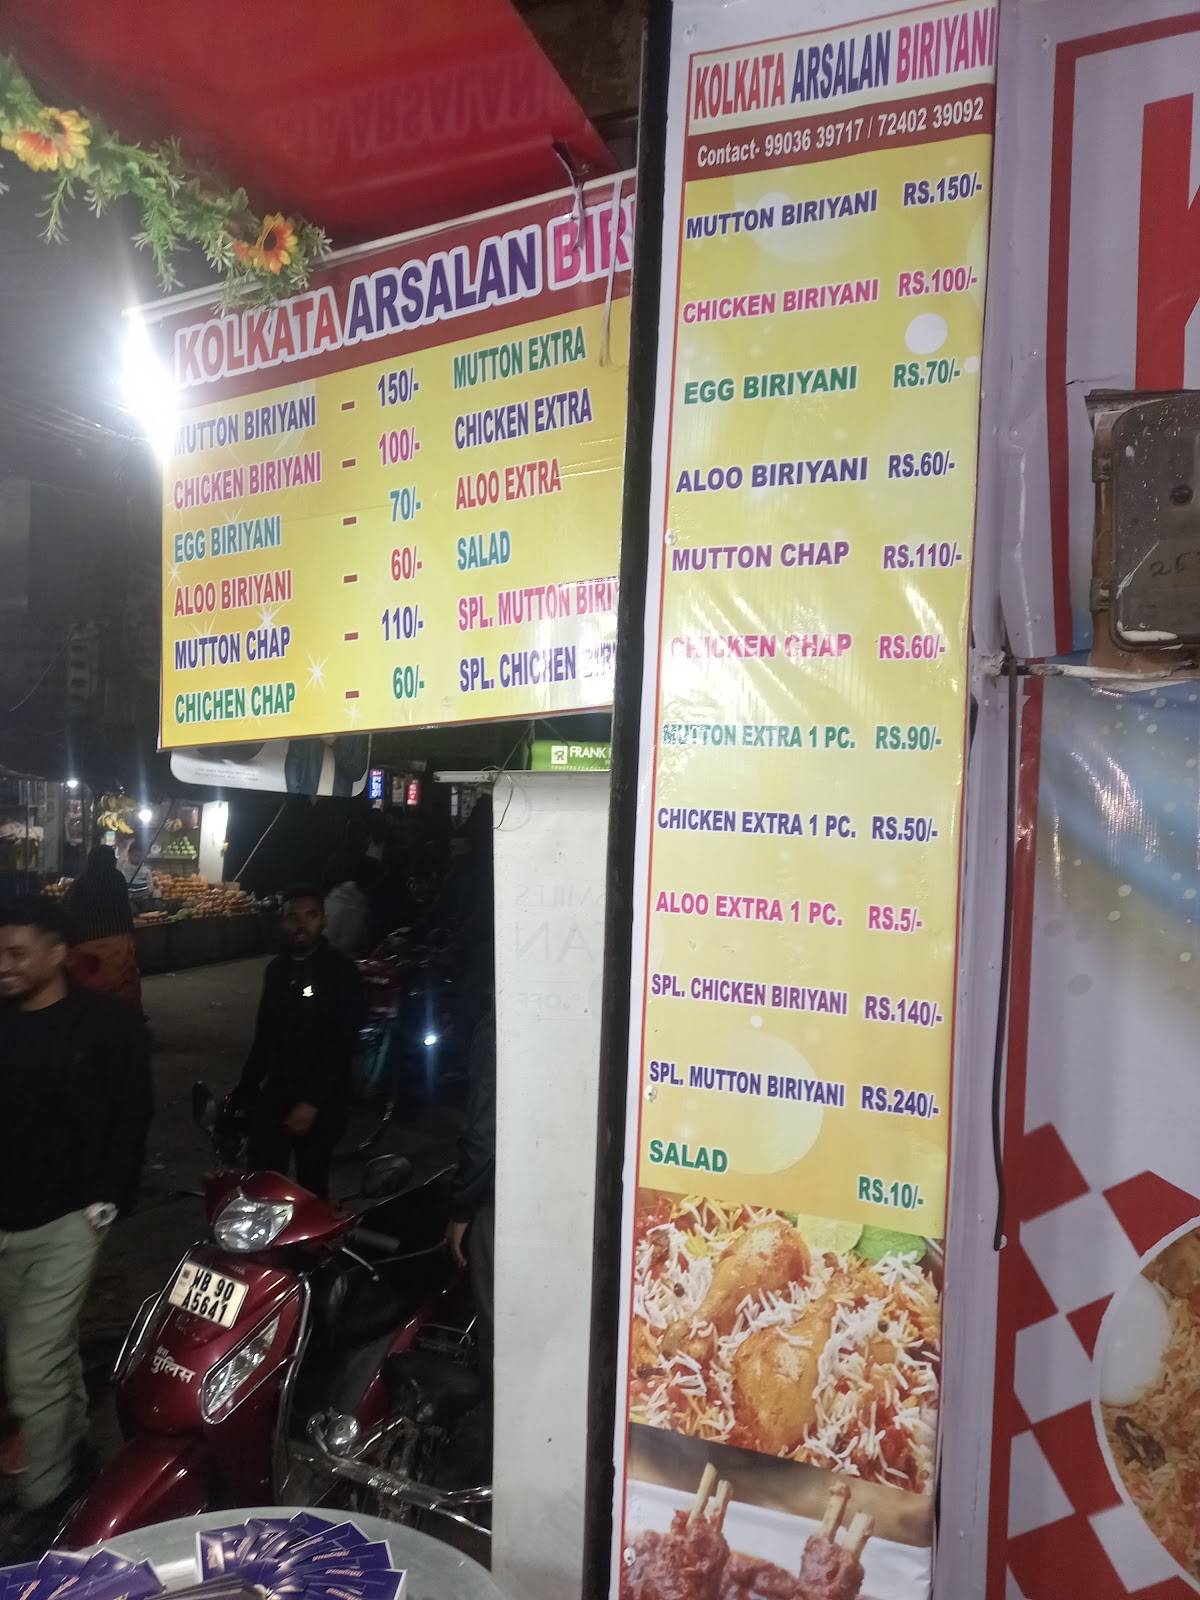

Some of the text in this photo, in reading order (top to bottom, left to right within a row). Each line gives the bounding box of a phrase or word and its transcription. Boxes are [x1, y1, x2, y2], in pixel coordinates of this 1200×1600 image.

[694, 7, 996, 120] KOLKATA ARSALAN BIRIYANI
[697, 140, 760, 167] Contact-
[765, 129, 811, 157] 99036
[816, 118, 863, 149] 39717
[878, 107, 927, 136] 72402
[932, 96, 984, 128] 39092
[686, 172, 982, 239] MUTTON BIRIYANI RS.150/-
[177, 203, 636, 384] KOLKATA ARSALAN BIR
[683, 266, 977, 324] CHICKEN BIRIYANI RS.100/-
[453, 326, 586, 389] MUTTON EXTRA
[684, 358, 960, 404] EGG BIRIYANI RS.70/-
[244, 396, 316, 440] BIRIYANI
[377, 367, 419, 407] 150/-
[454, 388, 592, 449] CHICKEN EXTRA
[174, 468, 243, 509] CHICKEN
[250, 451, 321, 494] BIRIYANI
[379, 428, 420, 465] 100/-
[456, 458, 562, 510] ALOO EXTRA
[676, 450, 955, 493] ALOO BIRIYANI RS.60/-
[174, 530, 205, 563] EGG
[211, 515, 281, 557] BIRIYANI
[389, 486, 421, 522] 70/-
[457, 530, 511, 570] SALAD
[174, 582, 215, 616] ALOO
[221, 569, 292, 609] BIRIYANI
[391, 546, 422, 581] 60/-
[672, 541, 962, 571] MUTTON CHAP RS.110/-
[459, 596, 493, 631] SPL.
[499, 584, 570, 626] MUTTON
[175, 633, 240, 670] MUTTON
[246, 626, 290, 661] CHAP
[381, 605, 423, 641] 110/-
[785, 633, 852, 658] CHAP
[879, 635, 945, 659] RS.60/-
[175, 687, 245, 724] CHICHEN
[251, 682, 296, 716] CHAP
[392, 665, 424, 699] 60/-
[460, 658, 494, 692] SPL.
[569, 745, 607, 759] FRANK
[742, 725, 801, 748] EXTRA
[809, 726, 818, 748] 1
[825, 726, 855, 749] PC.
[876, 726, 942, 751] RS.90/-
[658, 807, 938, 842] CHICKEN EXTRA 1 PC. RS.50/-
[656, 891, 922, 932] ALOO EXTRA 1 PC. RS.5/-
[651, 973, 942, 1027] SPL. CHICKEN BIRIYANI RS.140/-
[650, 1061, 939, 1118] SPL. MUTTON BIRIYANI RS.240/-
[649, 1139, 924, 1209] SALAD RS.10/-
[181, 1289, 229, 1324] A5641
[191, 1268, 235, 1300] WB 90
